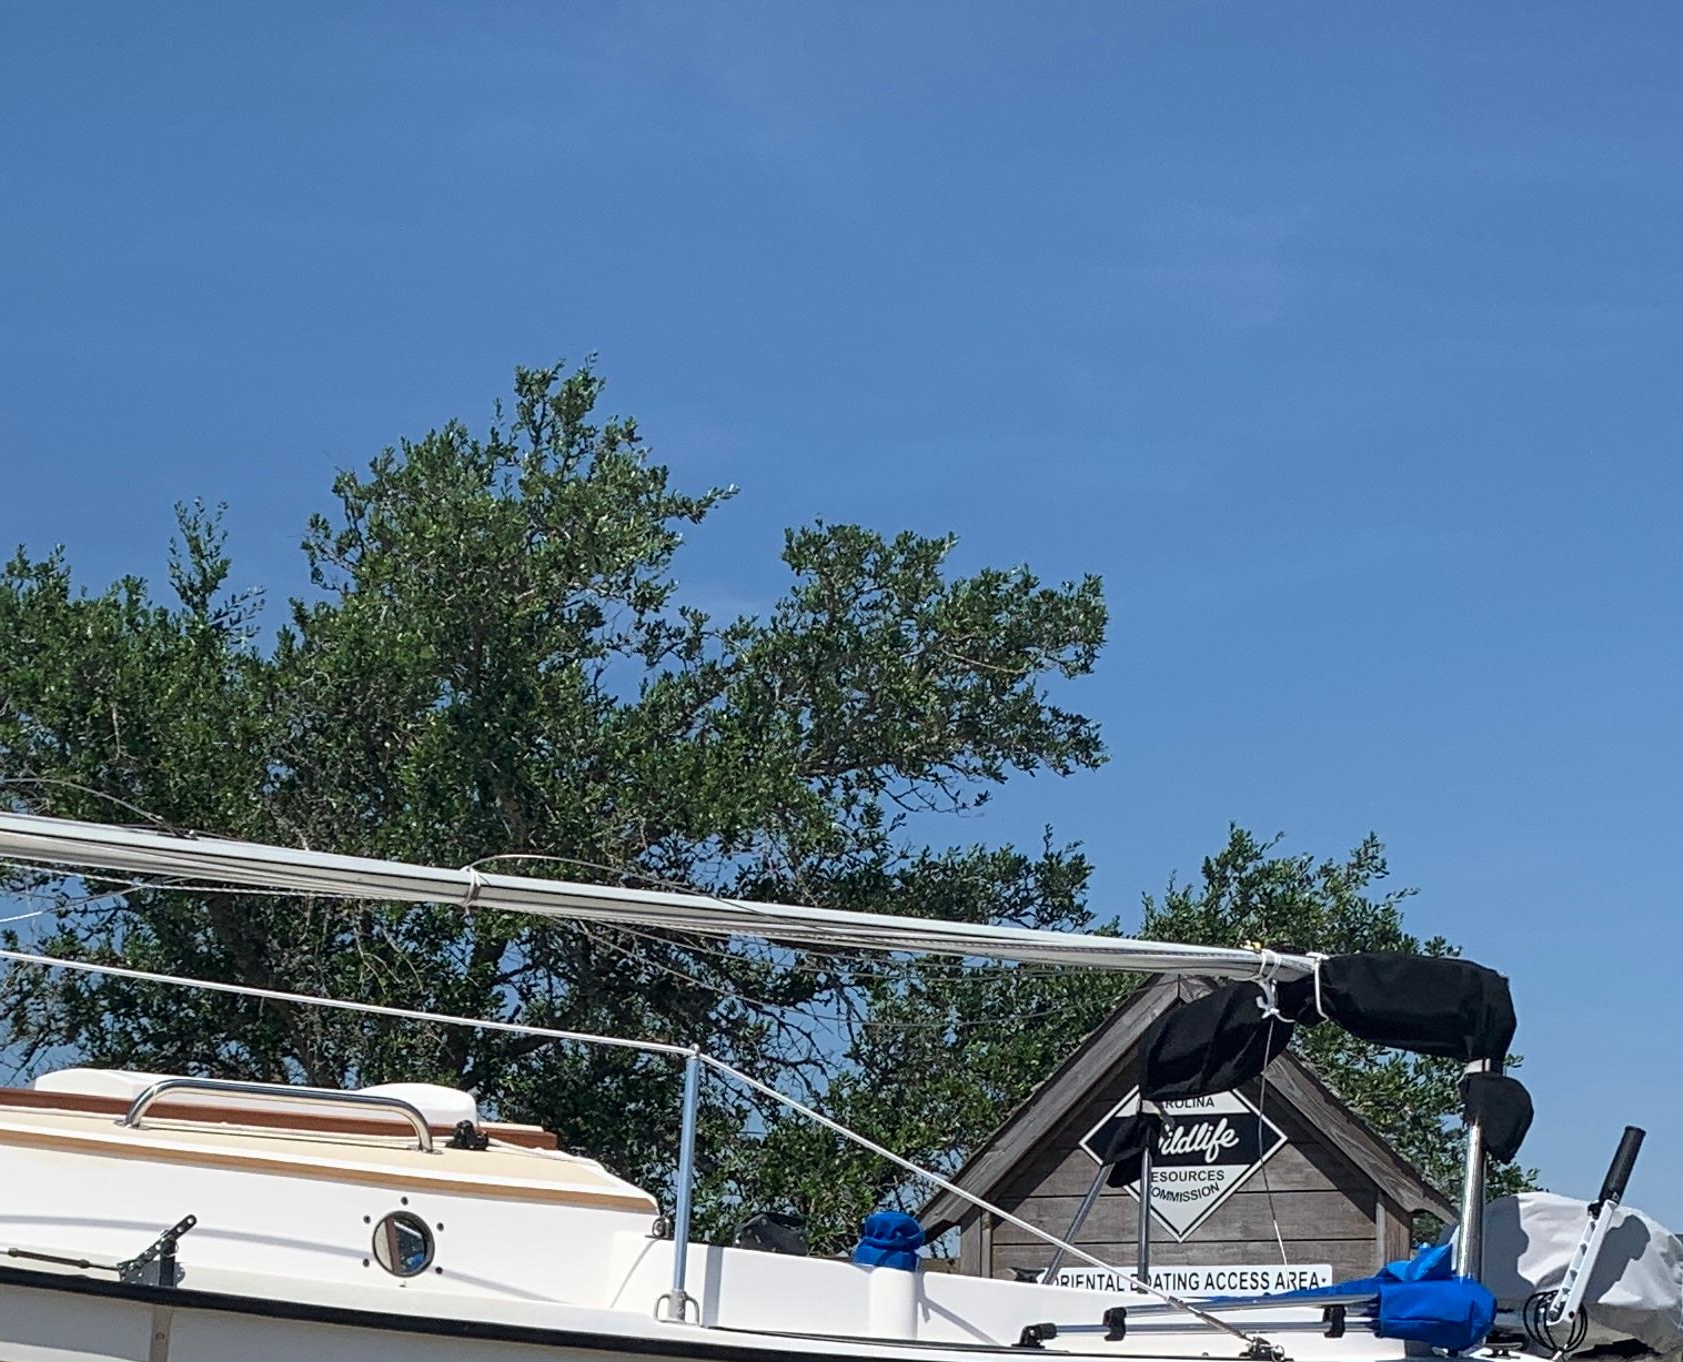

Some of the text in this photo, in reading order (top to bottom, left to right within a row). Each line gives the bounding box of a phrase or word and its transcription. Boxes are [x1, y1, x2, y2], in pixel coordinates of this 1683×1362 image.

[1164, 1097, 1215, 1109] ROLINA
[1158, 1117, 1240, 1163] ildlife
[1151, 1169, 1225, 1182] ESOURCES
[1150, 1182, 1220, 1203] OMMISSION
[1056, 1273, 1125, 1292] RIENTAL
[1204, 1271, 1270, 1290] ACCESS
[1274, 1271, 1320, 1290] AREA
